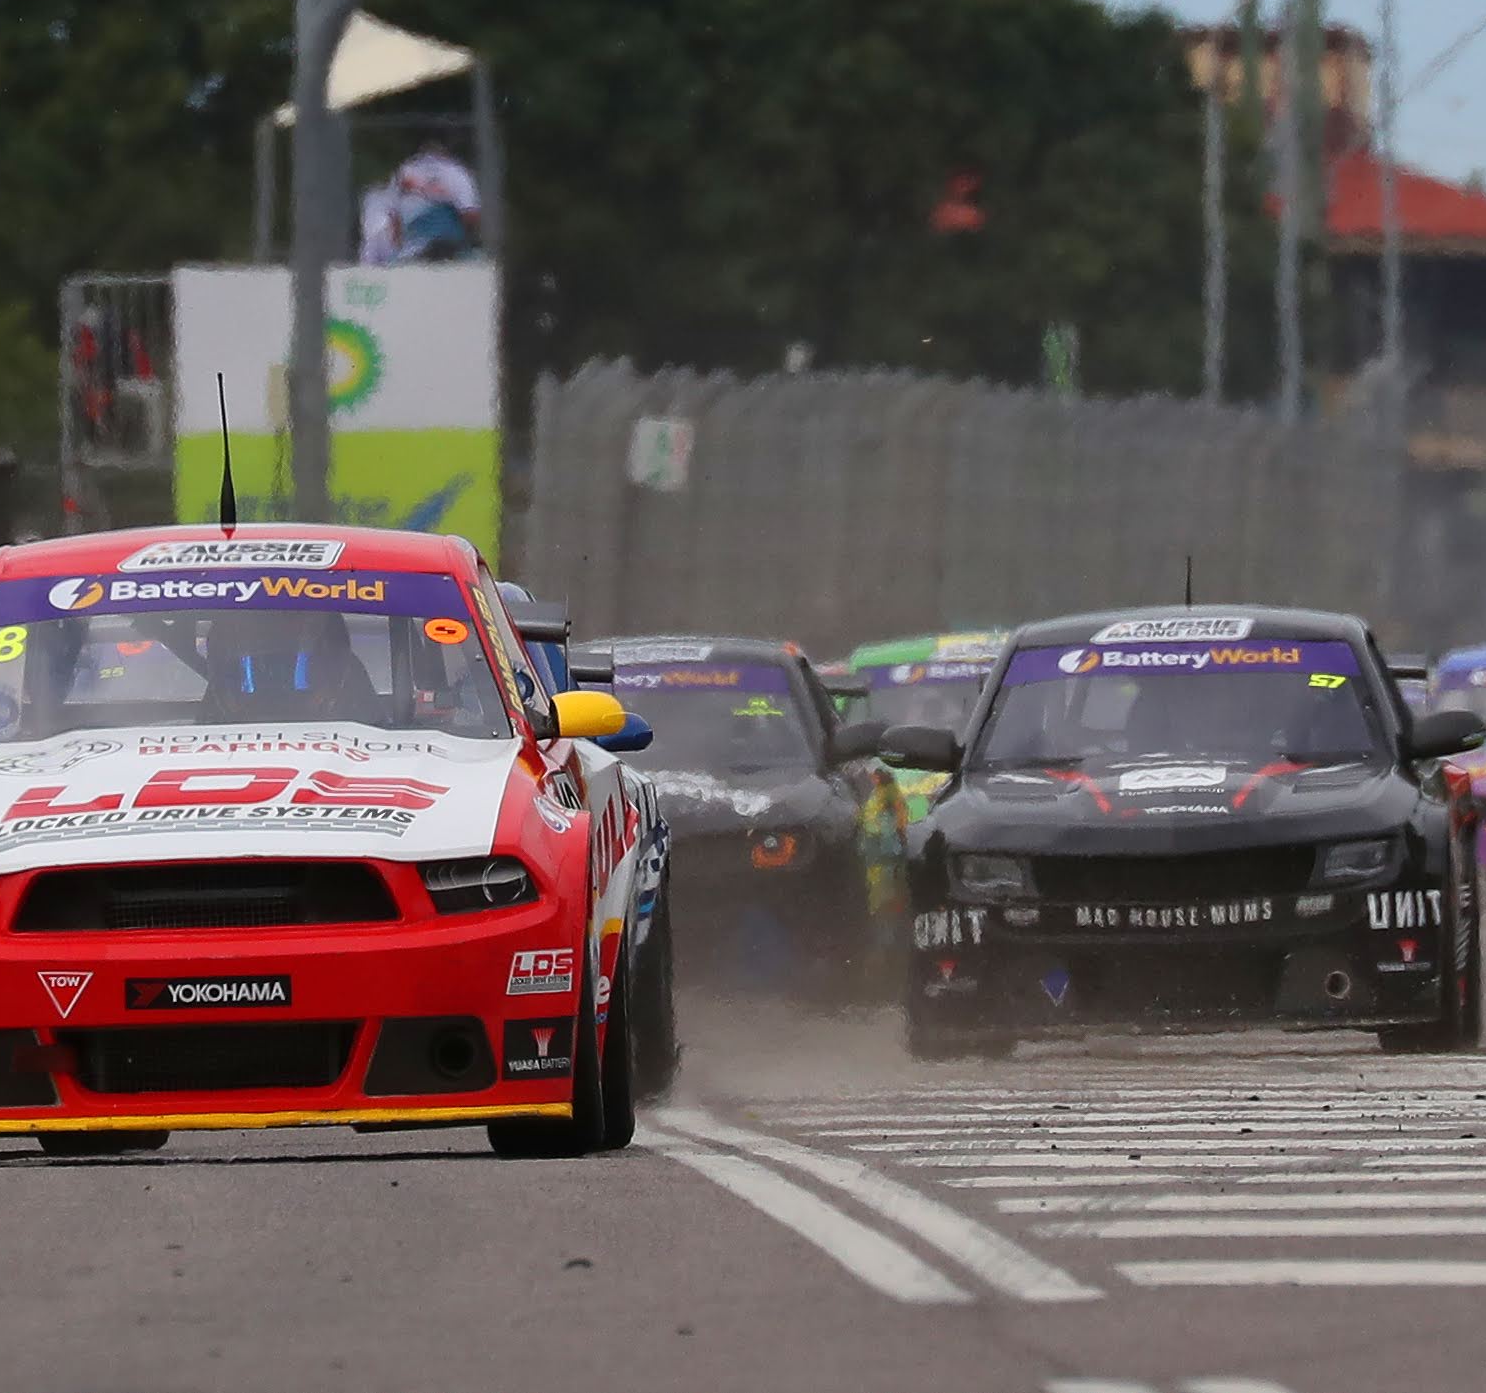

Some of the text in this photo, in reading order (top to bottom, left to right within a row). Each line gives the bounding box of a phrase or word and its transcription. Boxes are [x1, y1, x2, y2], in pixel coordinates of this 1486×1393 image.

[182, 542, 329, 555] AUSSIE
[139, 553, 324, 566] RACING CARS
[1135, 618, 1241, 631] AUSSIE
[1308, 674, 1346, 689] 57
[138, 730, 451, 759] NORTH SHORE
[138, 739, 373, 763] BEARINGS
[0, 766, 453, 823] LDS
[135, 805, 232, 823] DRIVE
[245, 804, 418, 825] SYSTEMS
[1144, 804, 1230, 814] YOKOHAMA
[512, 953, 572, 977] LDS
[48, 976, 80, 988] TOW
[167, 981, 286, 1003] YOKOHAMA
[508, 1057, 570, 1072] YUASA BATTERY
